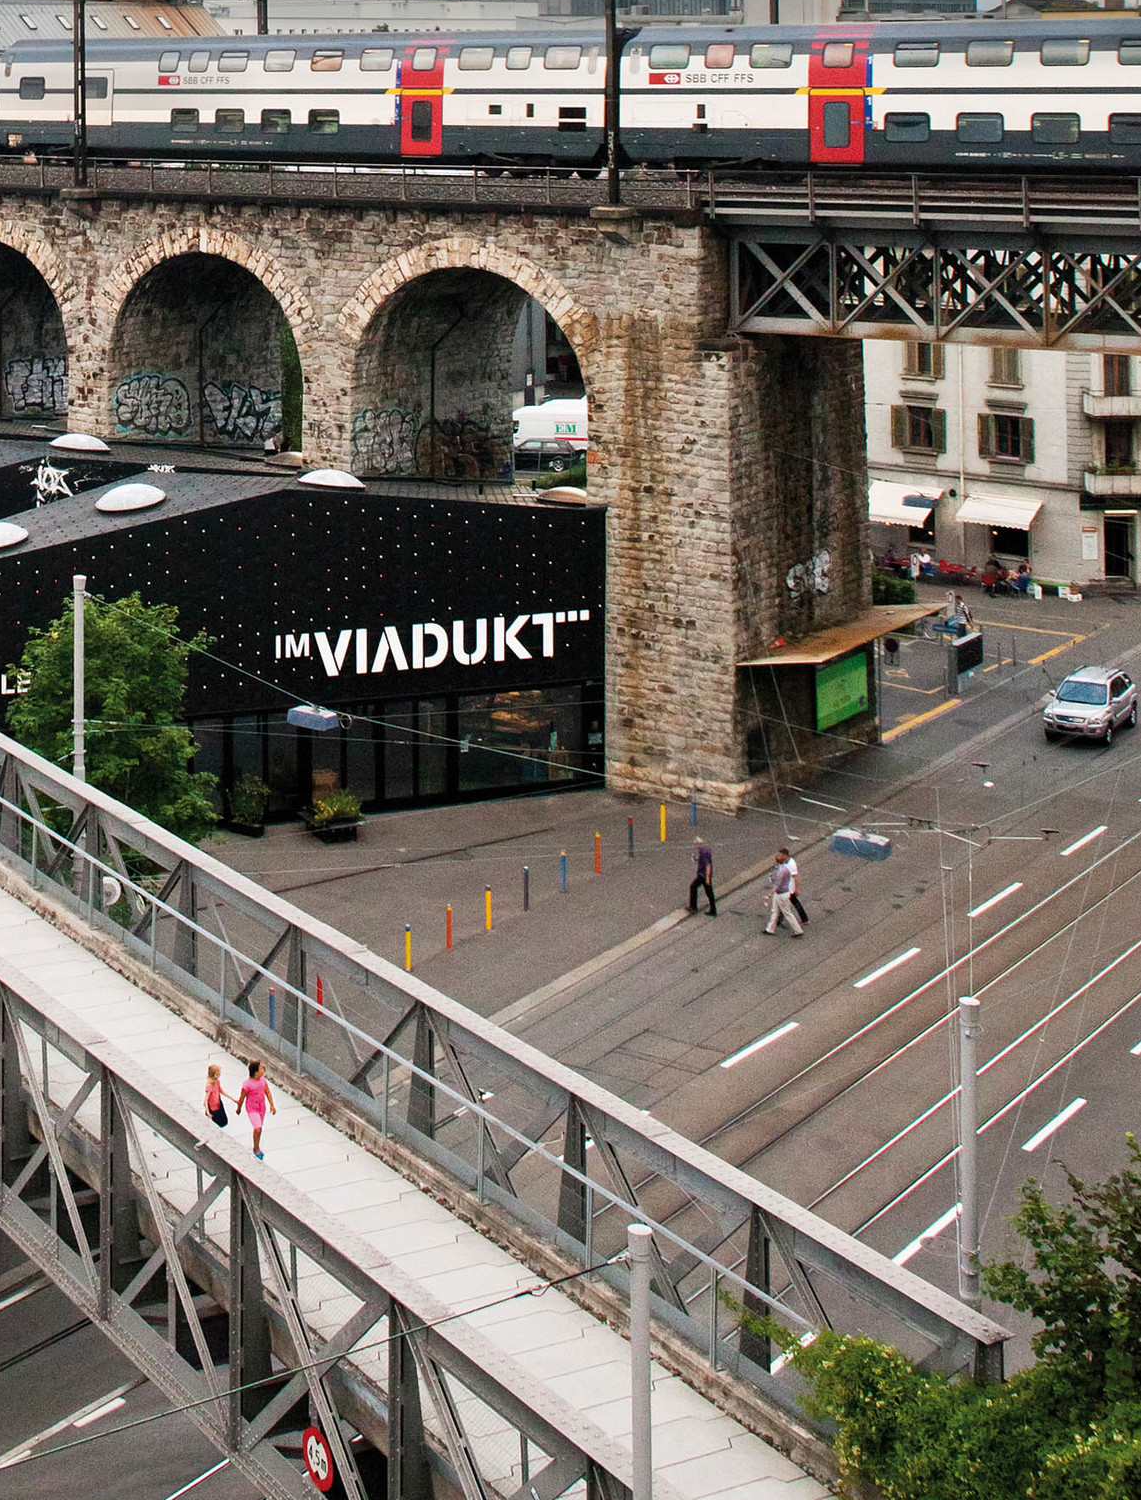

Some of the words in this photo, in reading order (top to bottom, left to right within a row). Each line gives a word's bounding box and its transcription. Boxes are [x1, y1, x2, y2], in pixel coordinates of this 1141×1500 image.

[183, 76, 198, 85] SBB
[200, 76, 214, 85] CFF
[216, 76, 230, 85] FFS
[685, 73, 707, 83] SBB
[710, 73, 730, 83] CFF
[734, 73, 754, 83] FFS
[555, 423, 577, 433] EM
[275, 632, 310, 659] IM
[314, 612, 554, 677] VIADUKT
